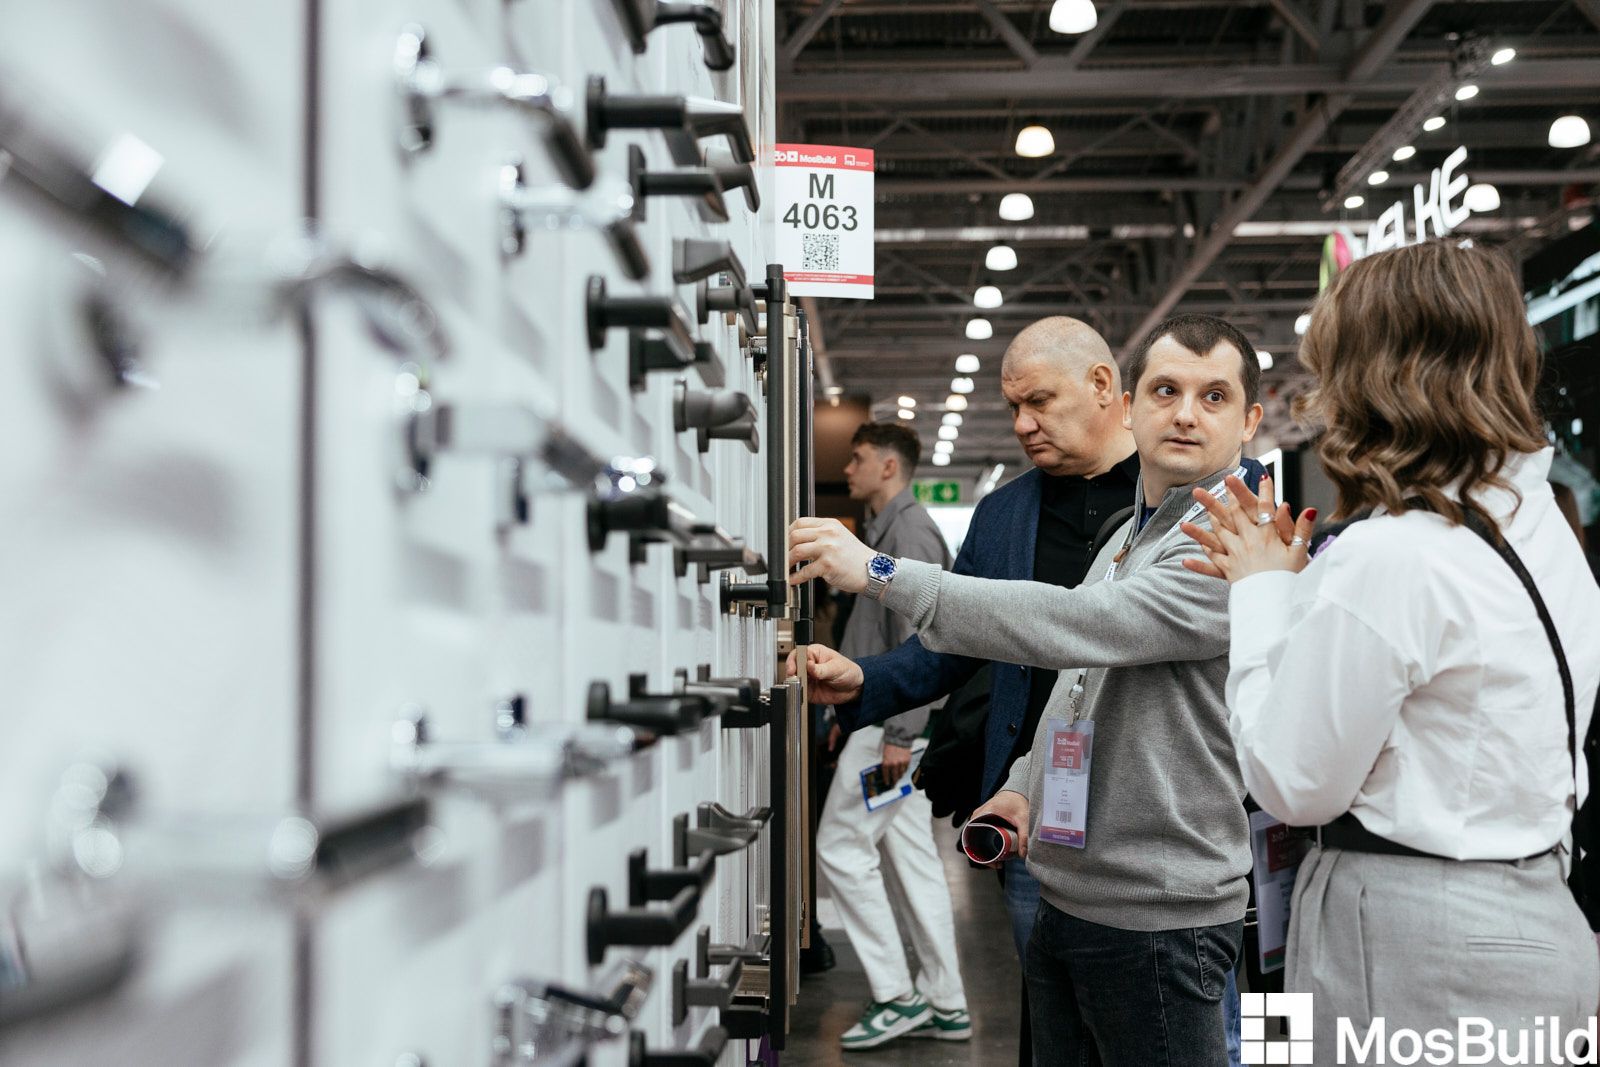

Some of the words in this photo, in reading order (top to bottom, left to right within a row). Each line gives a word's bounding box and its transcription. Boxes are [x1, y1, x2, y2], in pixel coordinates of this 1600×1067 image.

[800, 154, 837, 165] MosBuild
[809, 173, 834, 199] M
[783, 203, 858, 231] 4063
